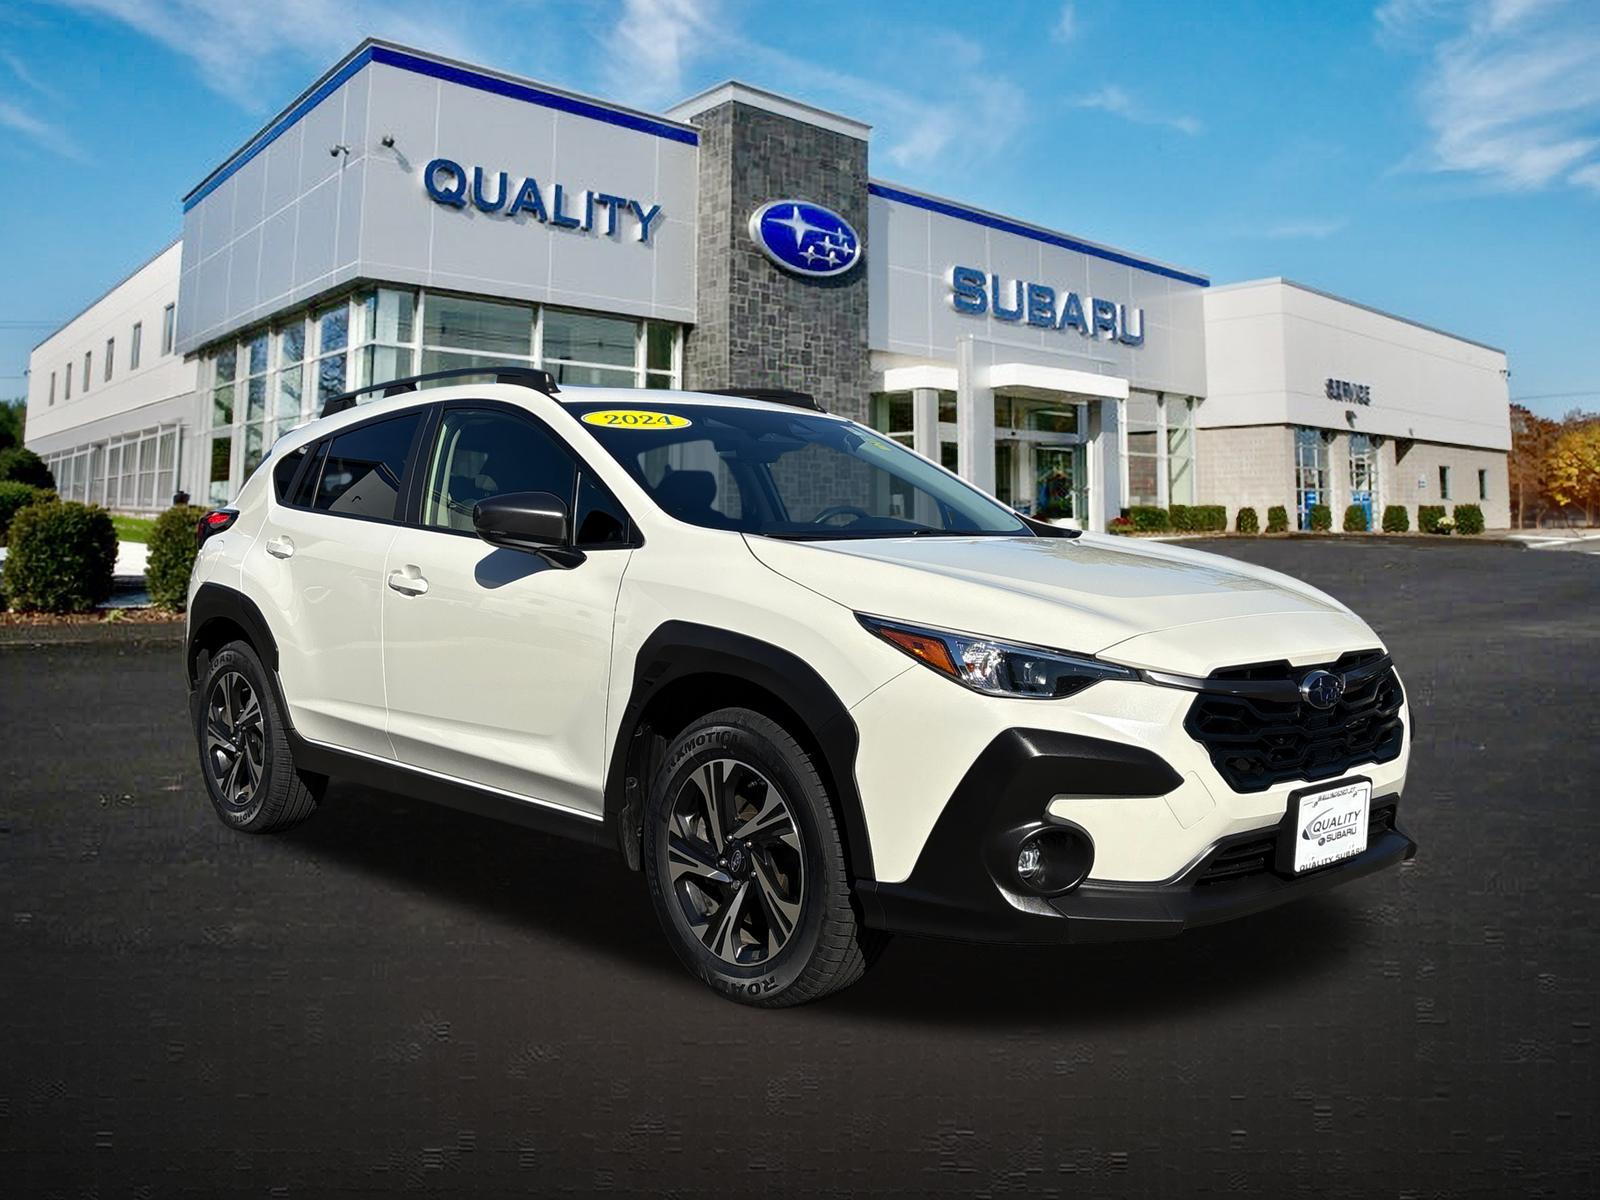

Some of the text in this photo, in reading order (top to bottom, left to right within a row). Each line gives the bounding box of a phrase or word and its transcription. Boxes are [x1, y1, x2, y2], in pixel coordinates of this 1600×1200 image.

[424, 158, 661, 243] QUALITY
[953, 265, 1144, 346] SUBARU
[604, 414, 673, 426] 2024
[1312, 809, 1362, 833] QUALITY
[1326, 827, 1357, 842] SUBARU
[1299, 855, 1334, 871] QUALITY
